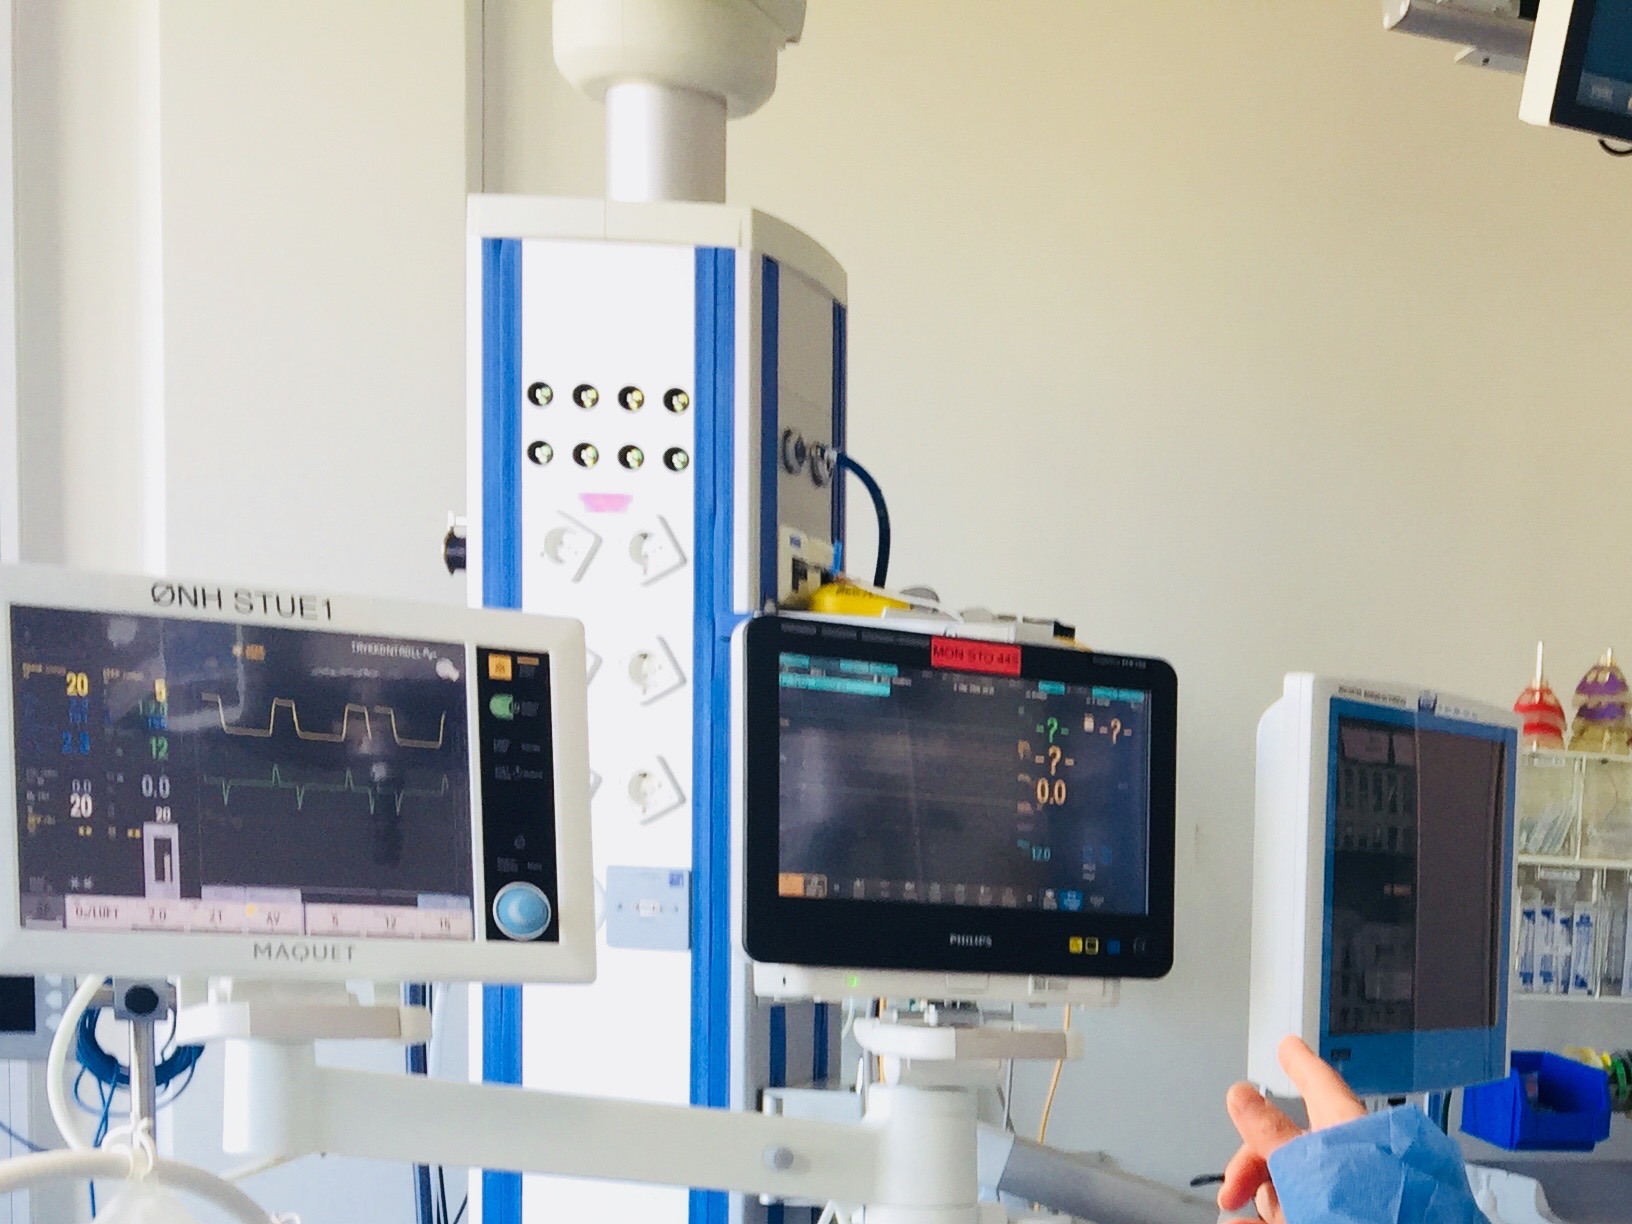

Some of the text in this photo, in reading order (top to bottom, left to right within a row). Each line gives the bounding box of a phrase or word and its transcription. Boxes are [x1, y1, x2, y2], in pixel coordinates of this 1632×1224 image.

[152, 581, 222, 611] ØNH
[933, 644, 964, 660] MON
[66, 671, 89, 697] 20
[150, 736, 169, 761] 12
[141, 773, 171, 799] 0.0
[1036, 777, 1067, 806] 0.0
[69, 792, 93, 818] 20
[155, 806, 172, 823] 20
[253, 942, 355, 963] MAQUET
[949, 933, 993, 948] PHILIPS
